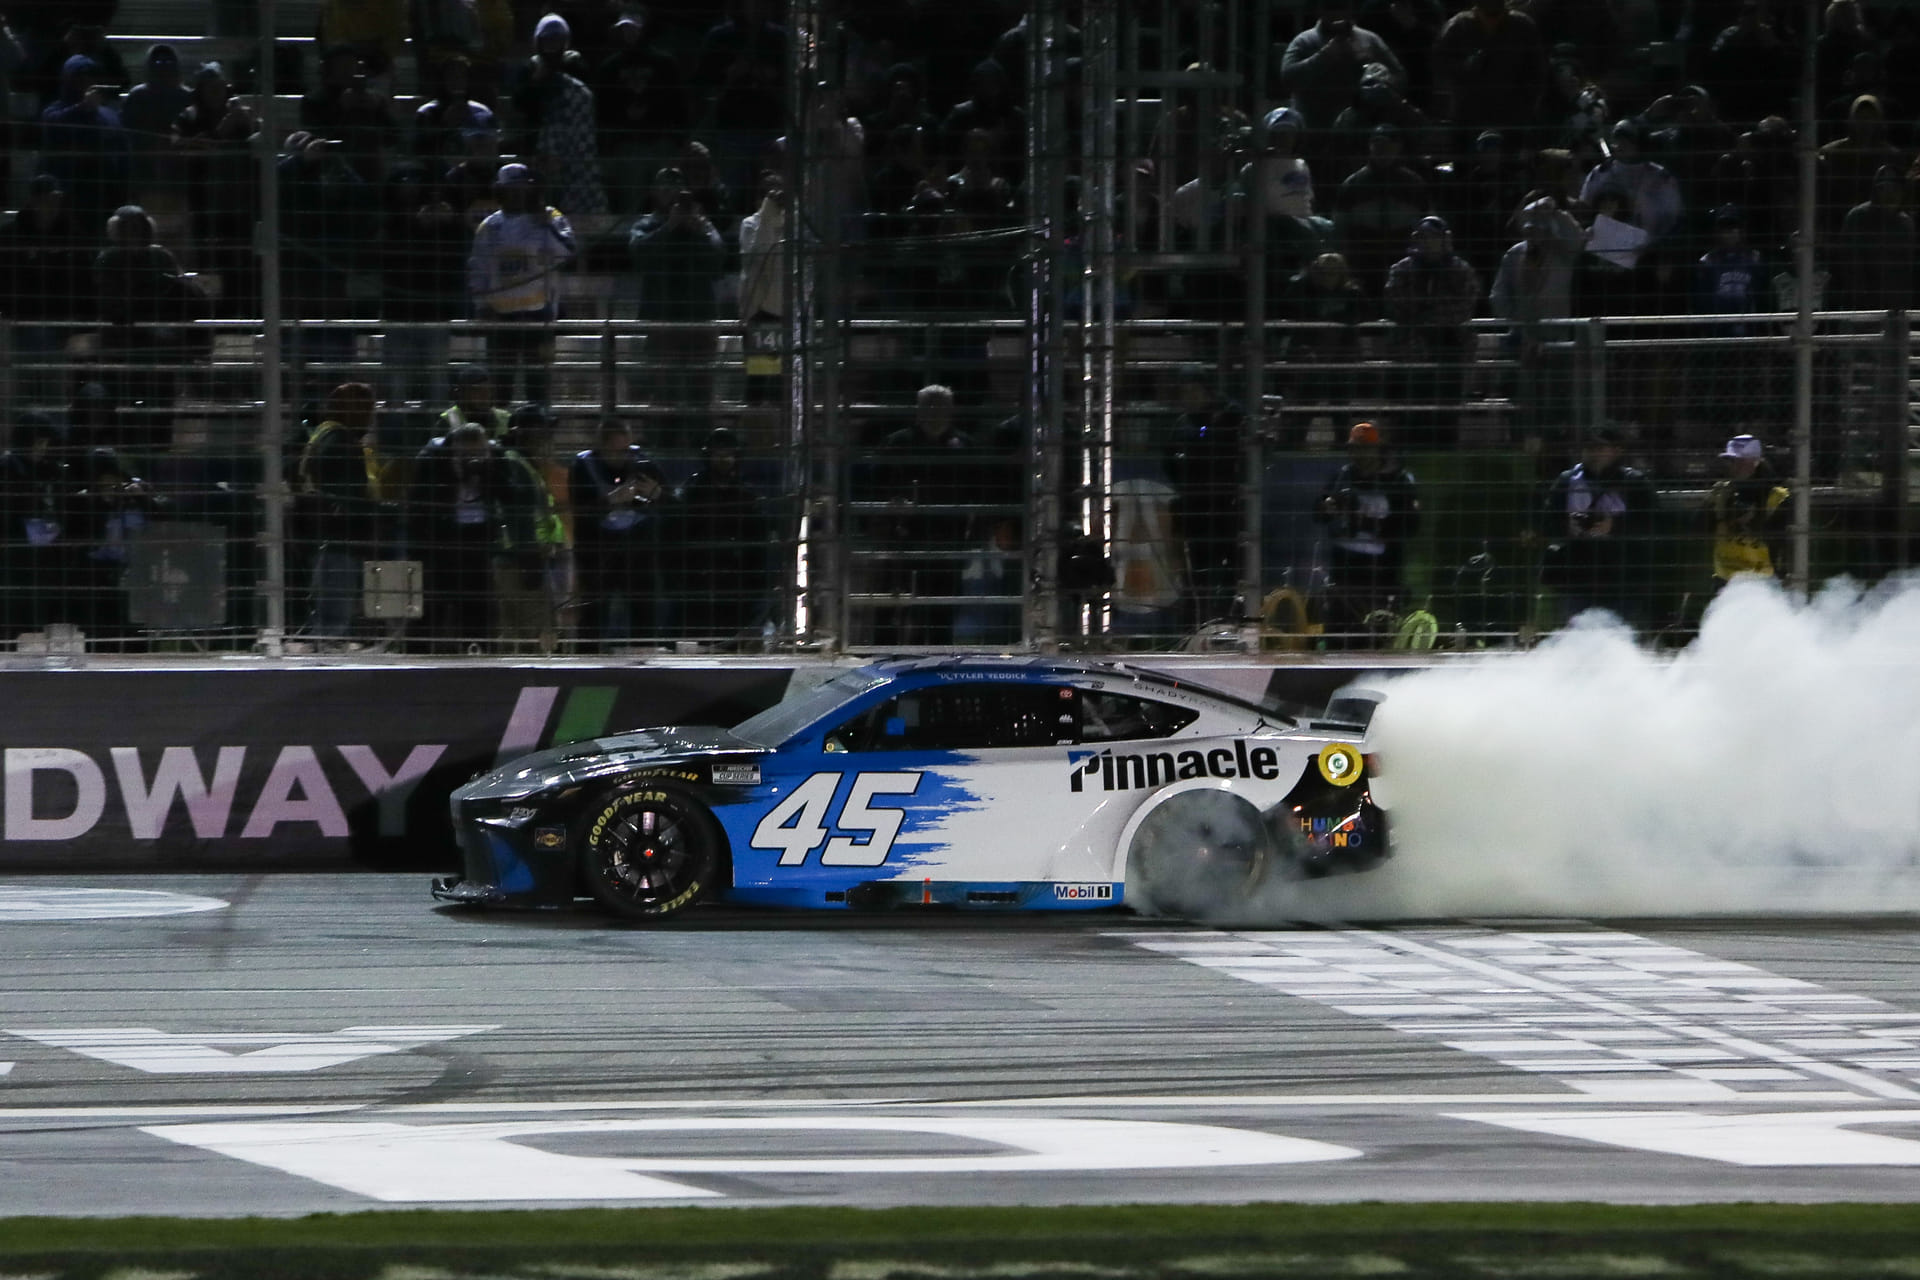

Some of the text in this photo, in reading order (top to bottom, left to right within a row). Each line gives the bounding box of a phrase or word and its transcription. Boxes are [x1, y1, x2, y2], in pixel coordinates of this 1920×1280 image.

[953, 672, 984, 680] TYLER
[1067, 739, 1280, 793] Pinnacle
[589, 791, 668, 846] GOODYEAR
[750, 770, 924, 867] 45
[1055, 886, 1110, 898] Mobil 1
